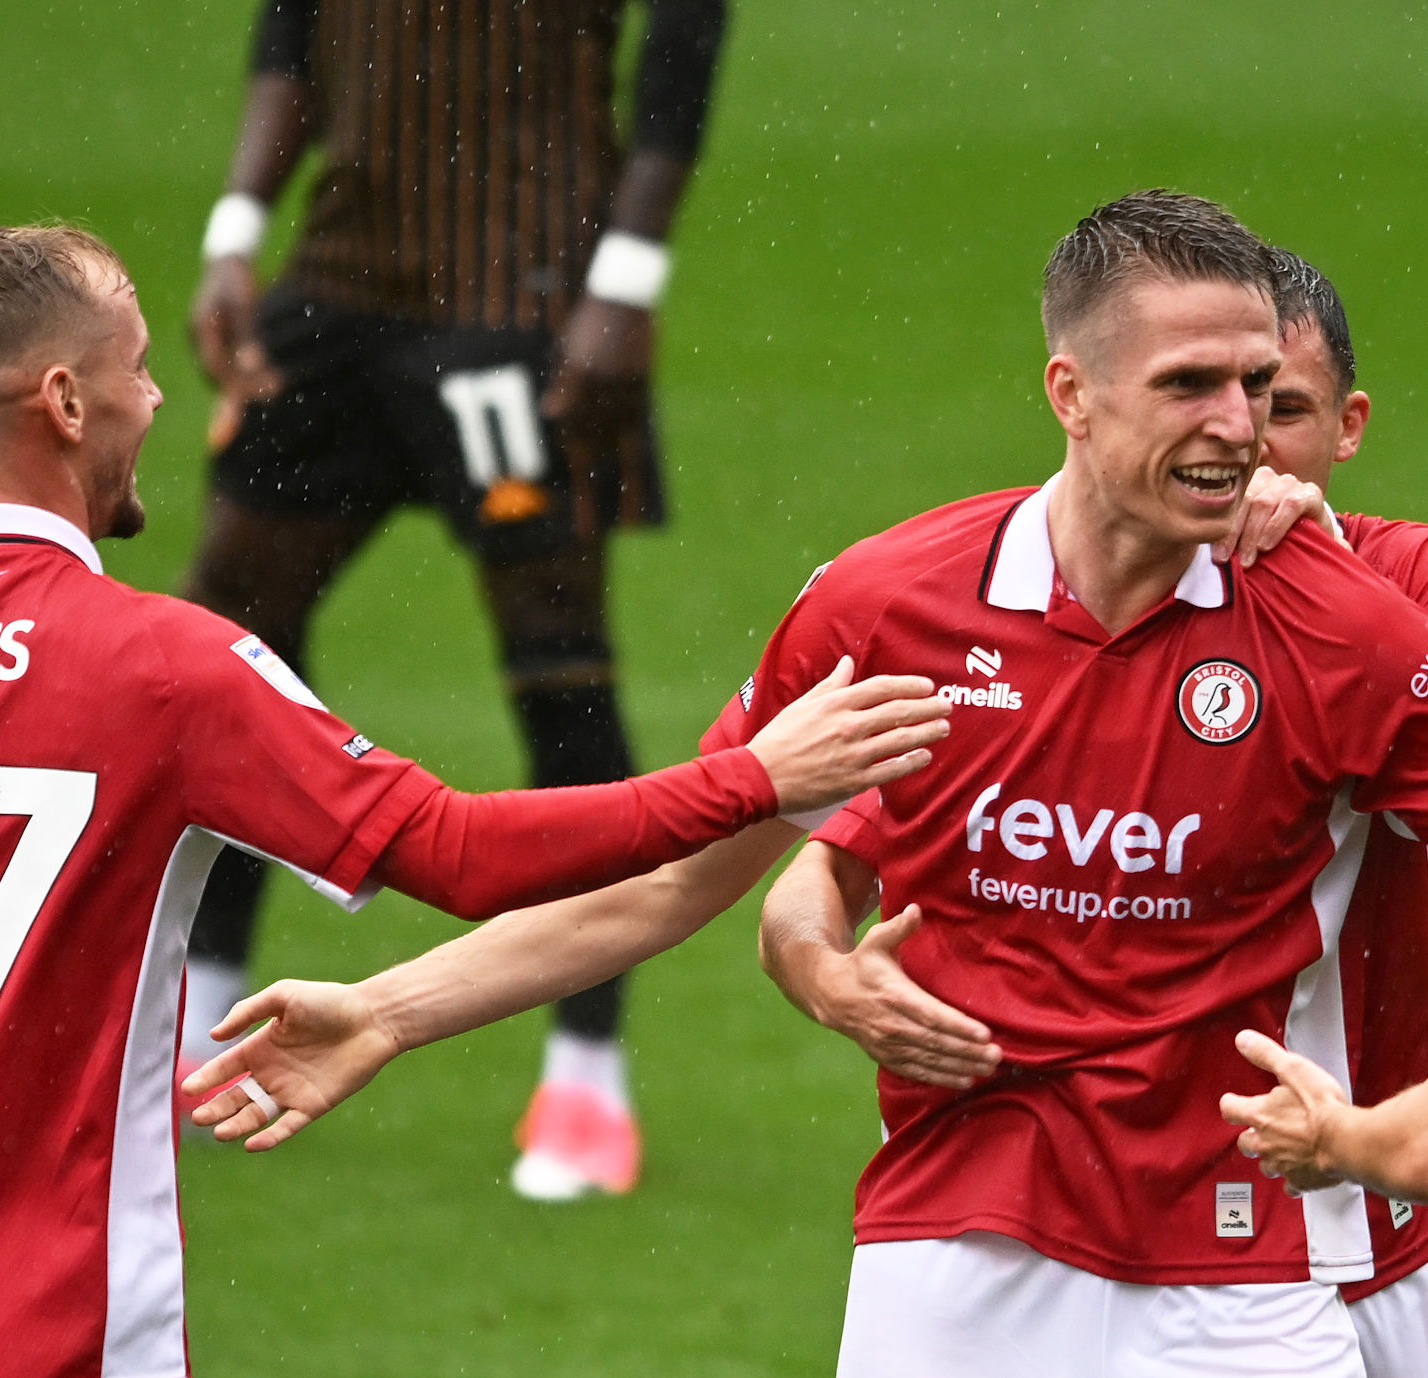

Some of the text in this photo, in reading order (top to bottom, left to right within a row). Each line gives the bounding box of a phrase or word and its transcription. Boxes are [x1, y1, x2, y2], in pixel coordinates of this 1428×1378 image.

[440, 363, 548, 488] 11
[1193, 666, 1246, 686] BRISTOL
[1201, 726, 1233, 738] CITY
[966, 782, 1201, 874] fever
[968, 867, 1192, 923] feverup.com
